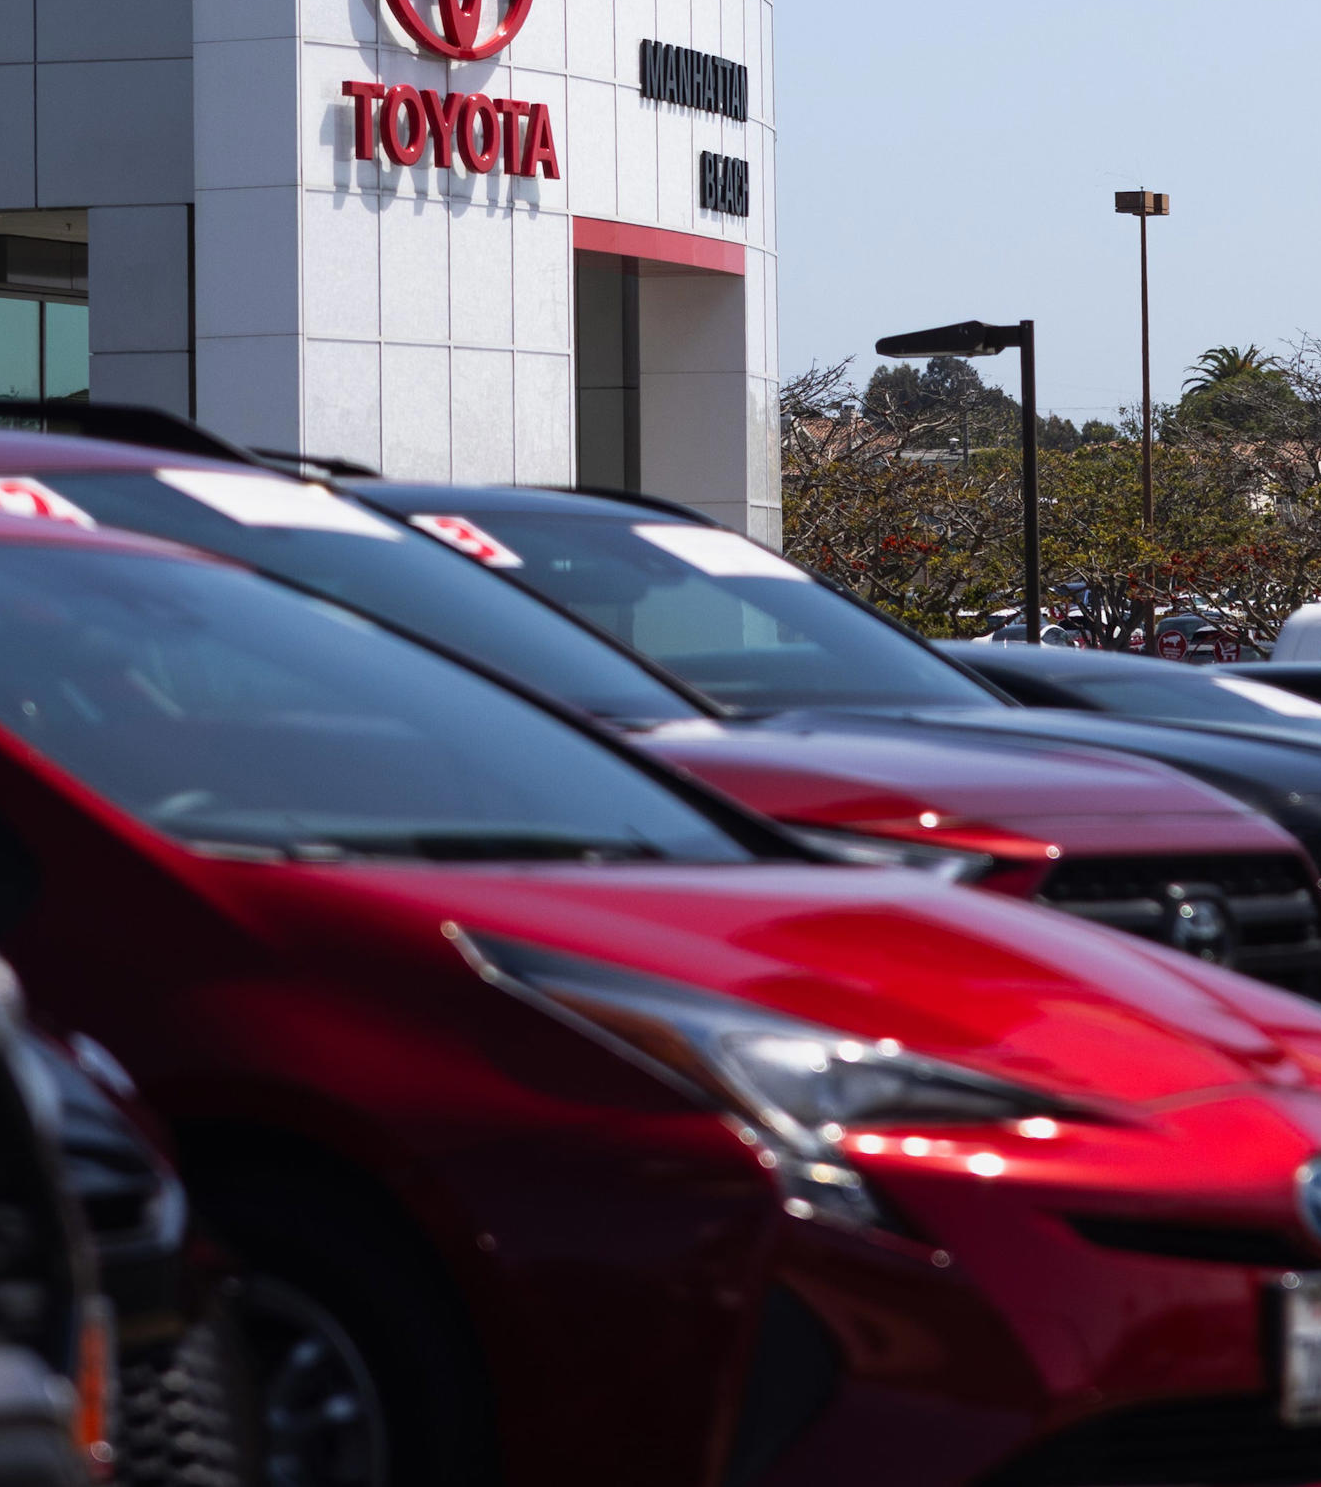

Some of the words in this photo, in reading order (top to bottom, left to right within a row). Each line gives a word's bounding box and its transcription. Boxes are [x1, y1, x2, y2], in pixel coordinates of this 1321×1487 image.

[639, 39, 749, 123] MANHATTAN
[342, 81, 560, 180] TOYOTA
[700, 150, 750, 218] BEACH
